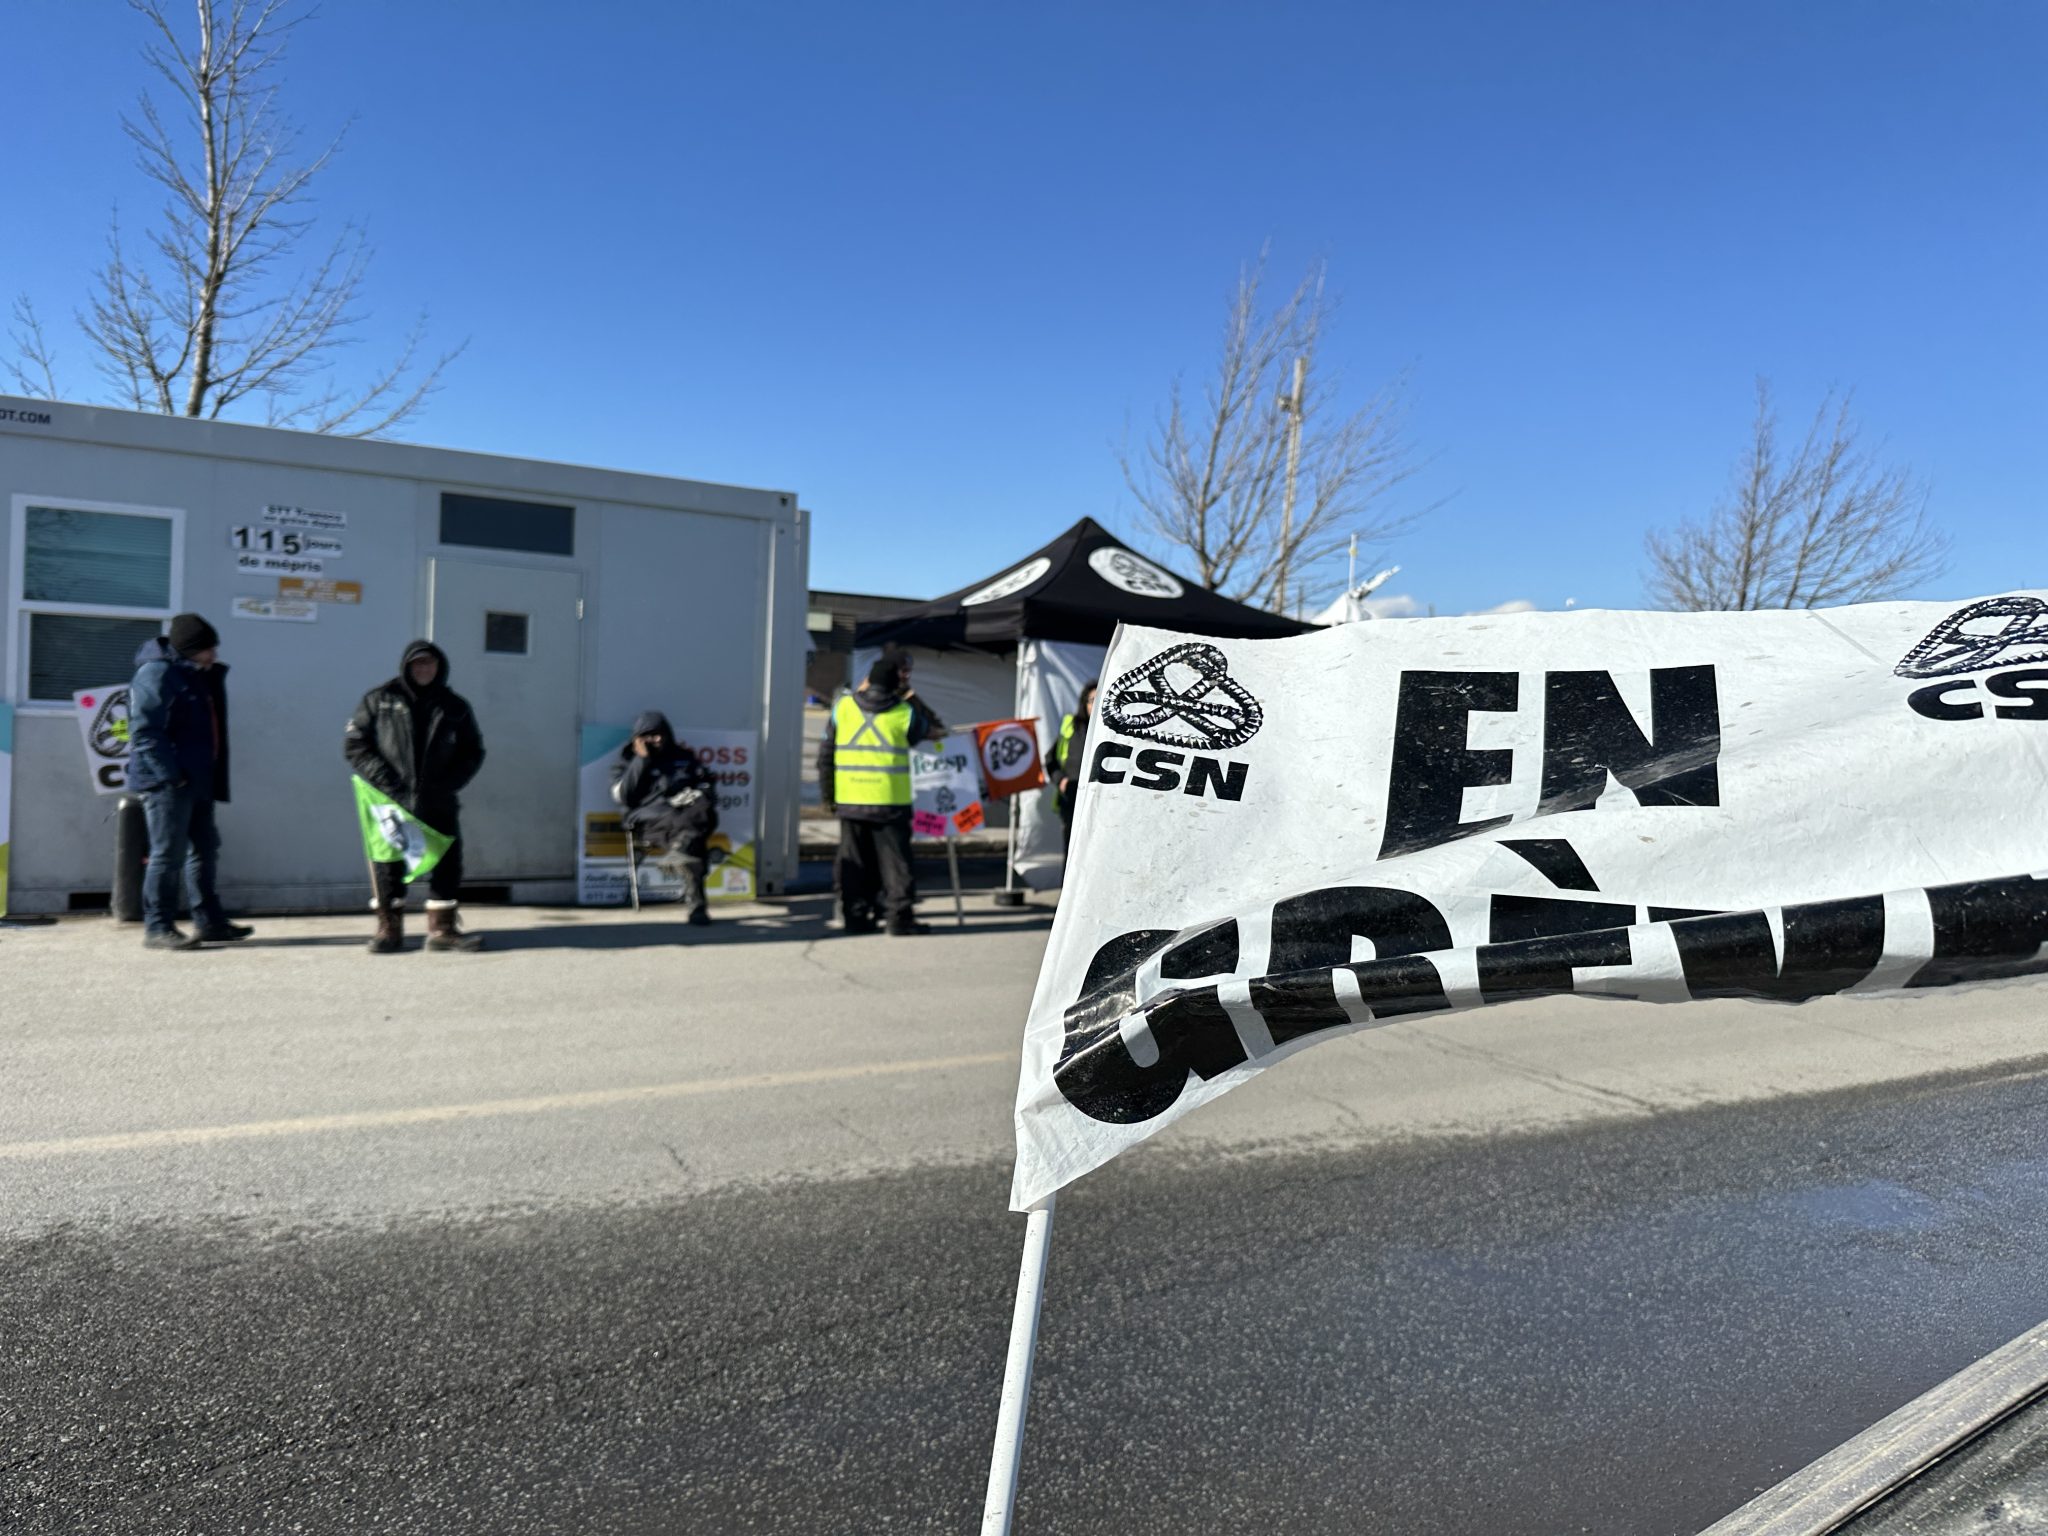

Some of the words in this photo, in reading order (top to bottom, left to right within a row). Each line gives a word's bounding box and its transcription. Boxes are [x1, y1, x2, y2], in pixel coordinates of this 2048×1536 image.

[235, 527, 301, 555] 115
[239, 556, 259, 567] de
[1907, 668, 2048, 721] CS
[1088, 741, 1249, 802] CSN
[1378, 664, 1720, 861] EN
